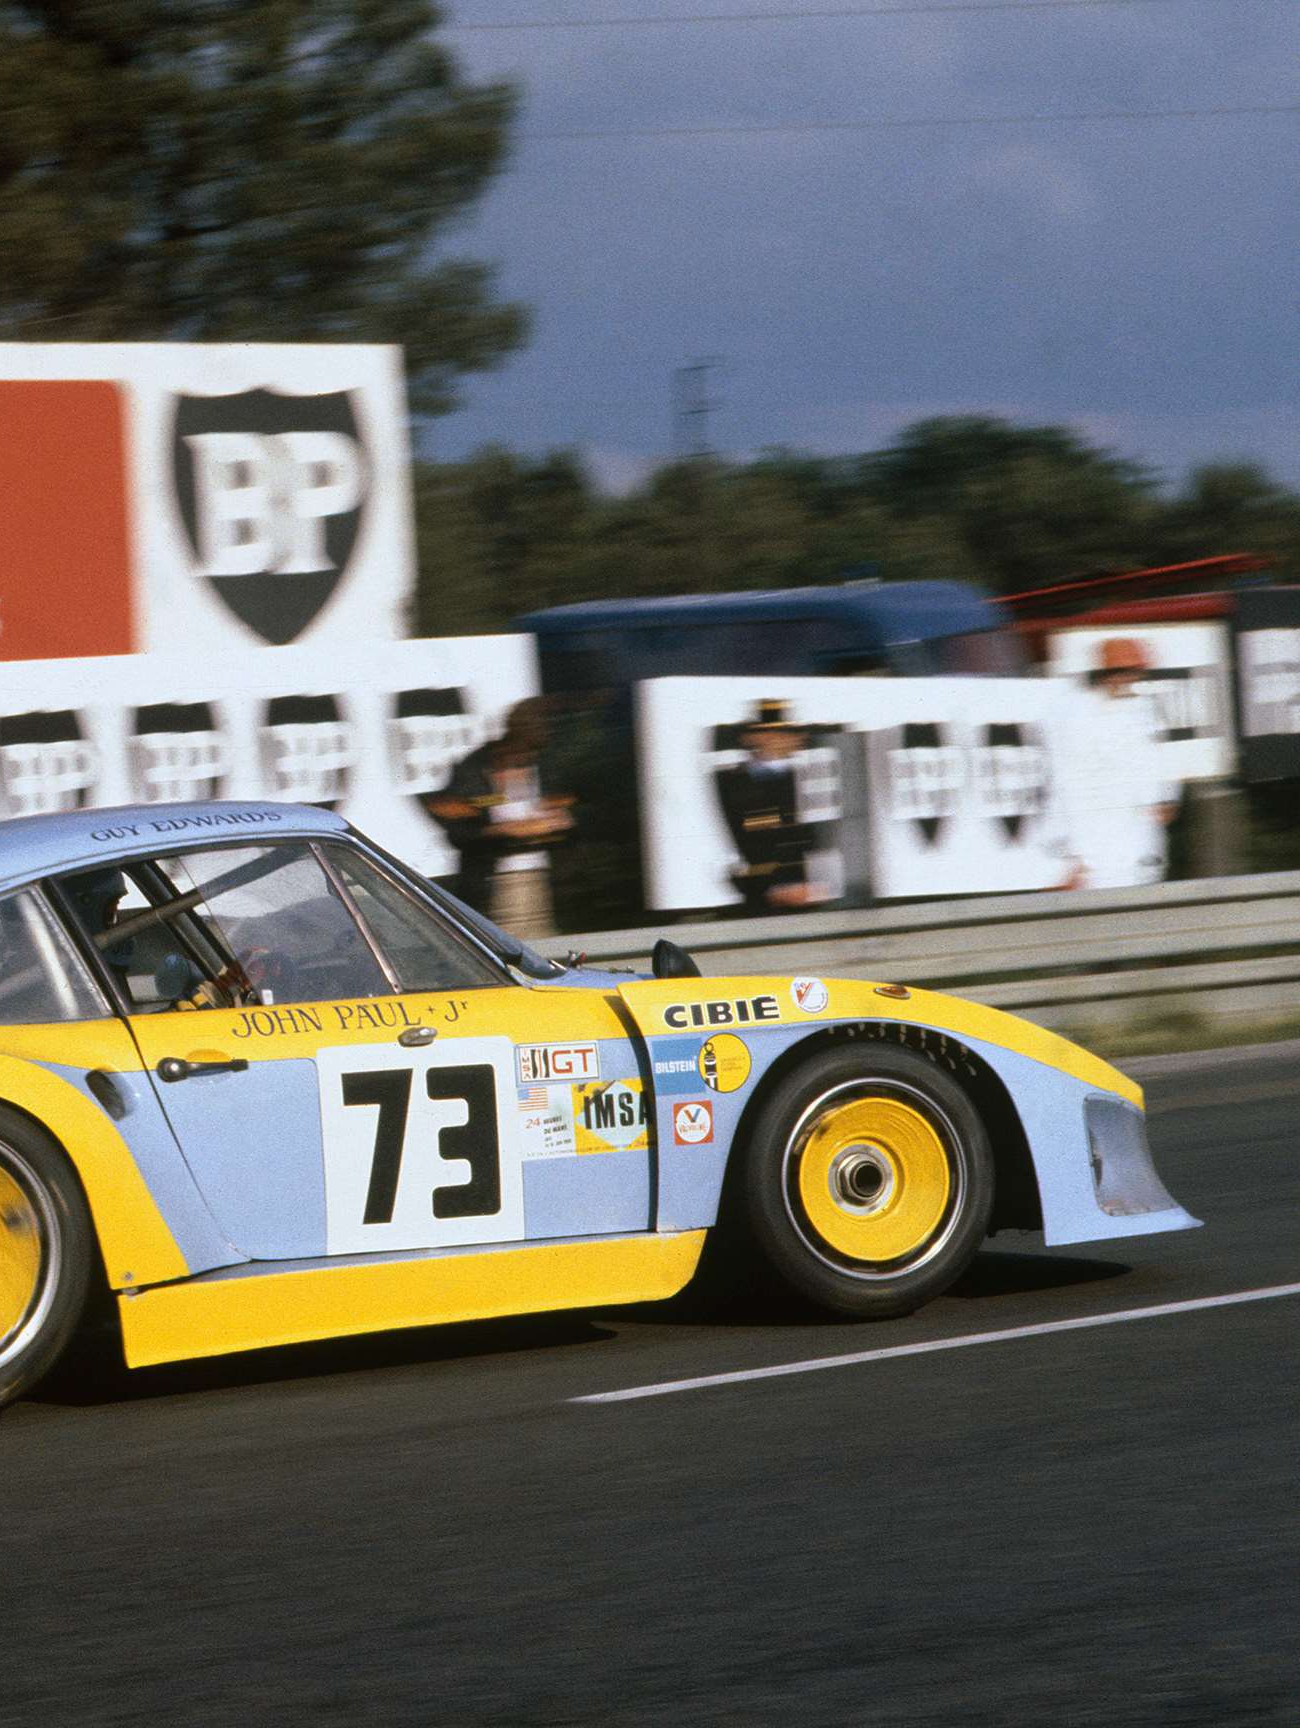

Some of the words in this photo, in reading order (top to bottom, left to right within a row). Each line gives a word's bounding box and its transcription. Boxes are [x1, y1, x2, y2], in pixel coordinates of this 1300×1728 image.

[184, 431, 364, 577] BP
[91, 823, 141, 842] GUY
[150, 810, 283, 833] EDWARDS
[231, 1007, 323, 1039] JOHN
[333, 1001, 422, 1030] PAUL
[444, 999, 470, 1023] Jr
[551, 1047, 594, 1074] GT
[654, 1058, 697, 1074] BILSTEIN
[525, 1117, 541, 1129] 24
[583, 1088, 651, 1130] IMSA
[340, 1063, 502, 1226] 73
